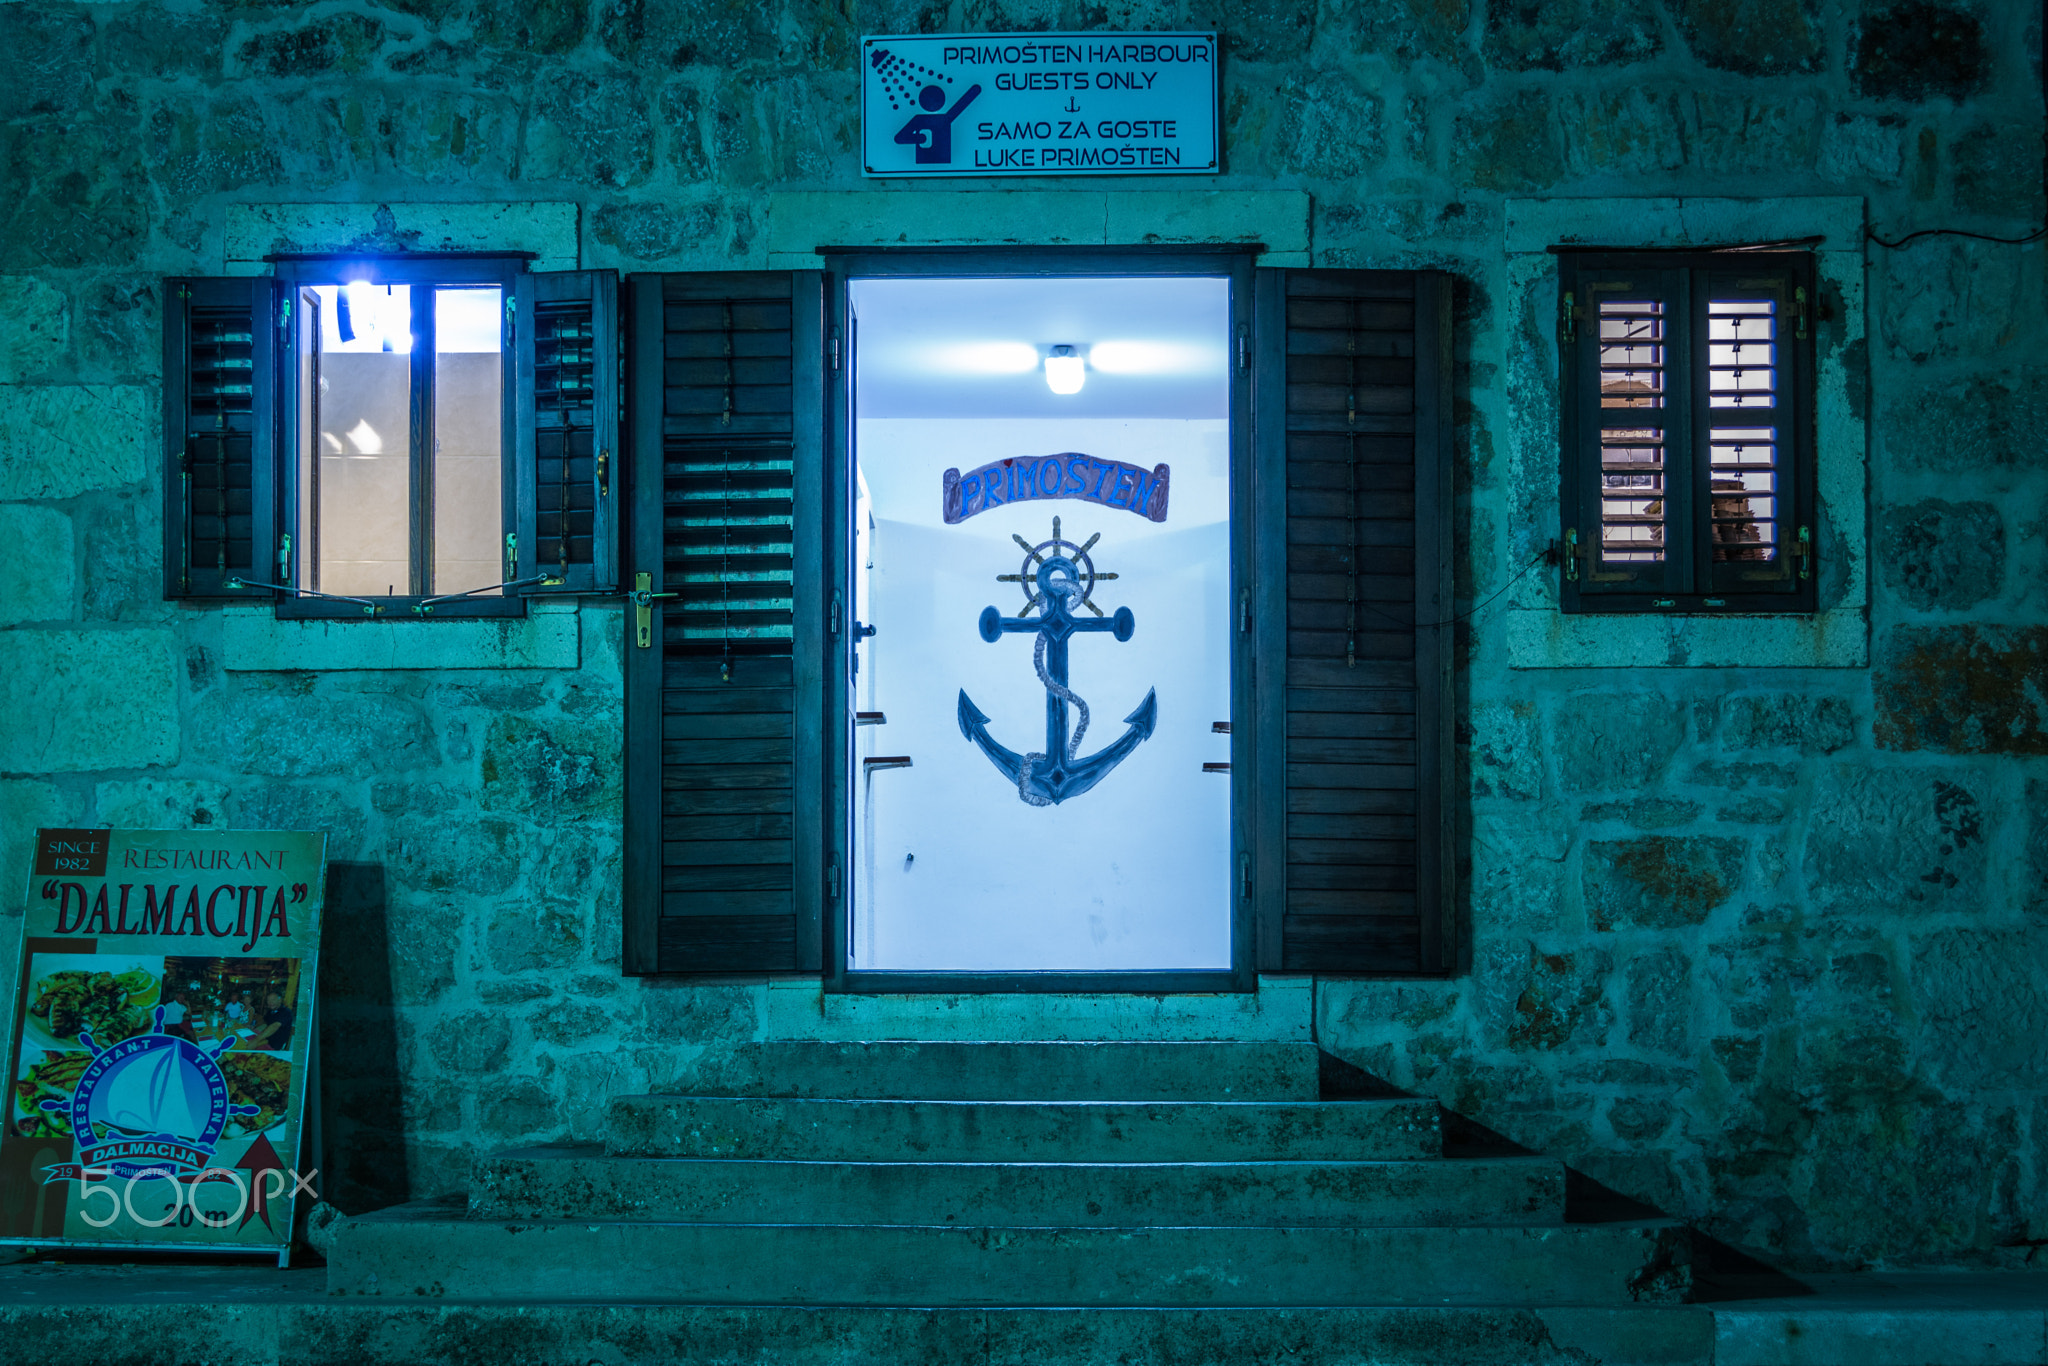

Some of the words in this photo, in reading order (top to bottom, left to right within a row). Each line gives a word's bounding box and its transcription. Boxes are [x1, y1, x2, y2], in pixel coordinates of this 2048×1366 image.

[943, 41, 1082, 65] PRIMOŠTEN
[1088, 44, 1209, 63] HARBOUR
[995, 72, 1089, 91] GUESTS
[1096, 71, 1157, 90] ONLY
[977, 121, 1052, 140] SAMO
[1058, 121, 1091, 139] ZA
[1097, 120, 1177, 139] GOSTE
[974, 149, 1035, 167] LUKE
[1041, 143, 1181, 166] PRIMOŠTEN
[959, 453, 1161, 518] PRIMOŠTEN
[48, 840, 100, 855] SINCE
[123, 848, 290, 870] RESTAURANT
[54, 857, 90, 871] 1982
[77, 1038, 152, 1138] RESTAURANT
[195, 1052, 226, 1136] TAVERNA
[91, 1142, 199, 1166] DALMACIJA
[58, 1167, 73, 1177] 19
[162, 1203, 194, 1228] 20
[203, 1209, 228, 1229] m
